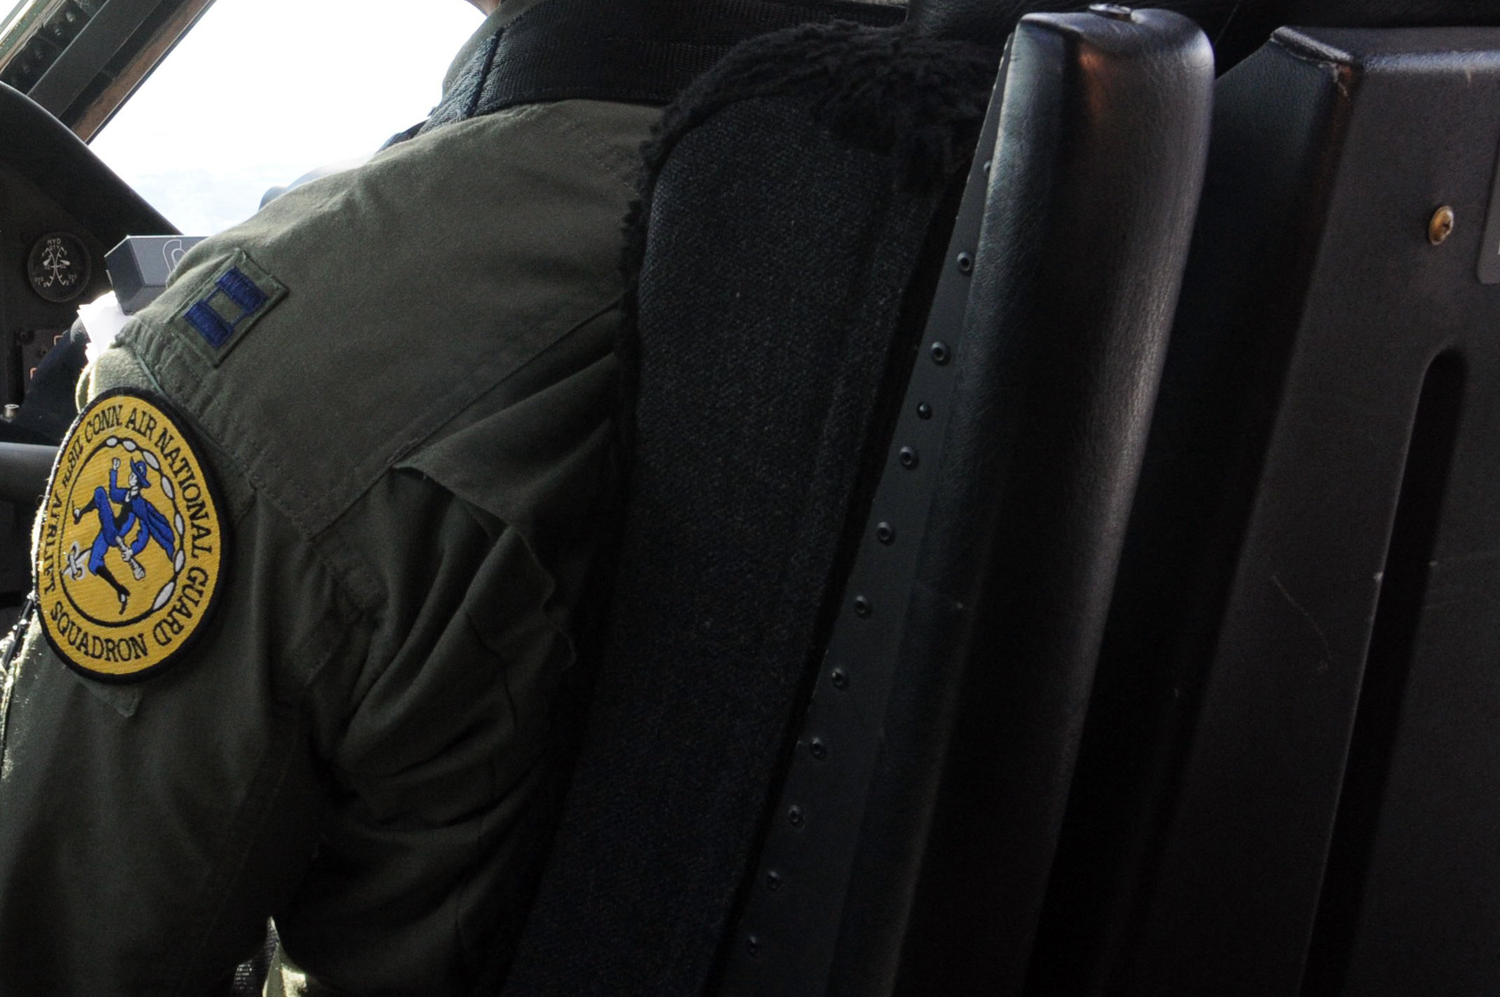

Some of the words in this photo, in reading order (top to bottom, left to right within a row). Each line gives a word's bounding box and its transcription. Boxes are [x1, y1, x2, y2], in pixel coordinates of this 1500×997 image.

[84, 404, 122, 443] CONN
[125, 408, 157, 440] AIR
[158, 427, 212, 559] NATIONAL
[50, 600, 148, 662] SQUADRON
[152, 566, 209, 646] GUARD
